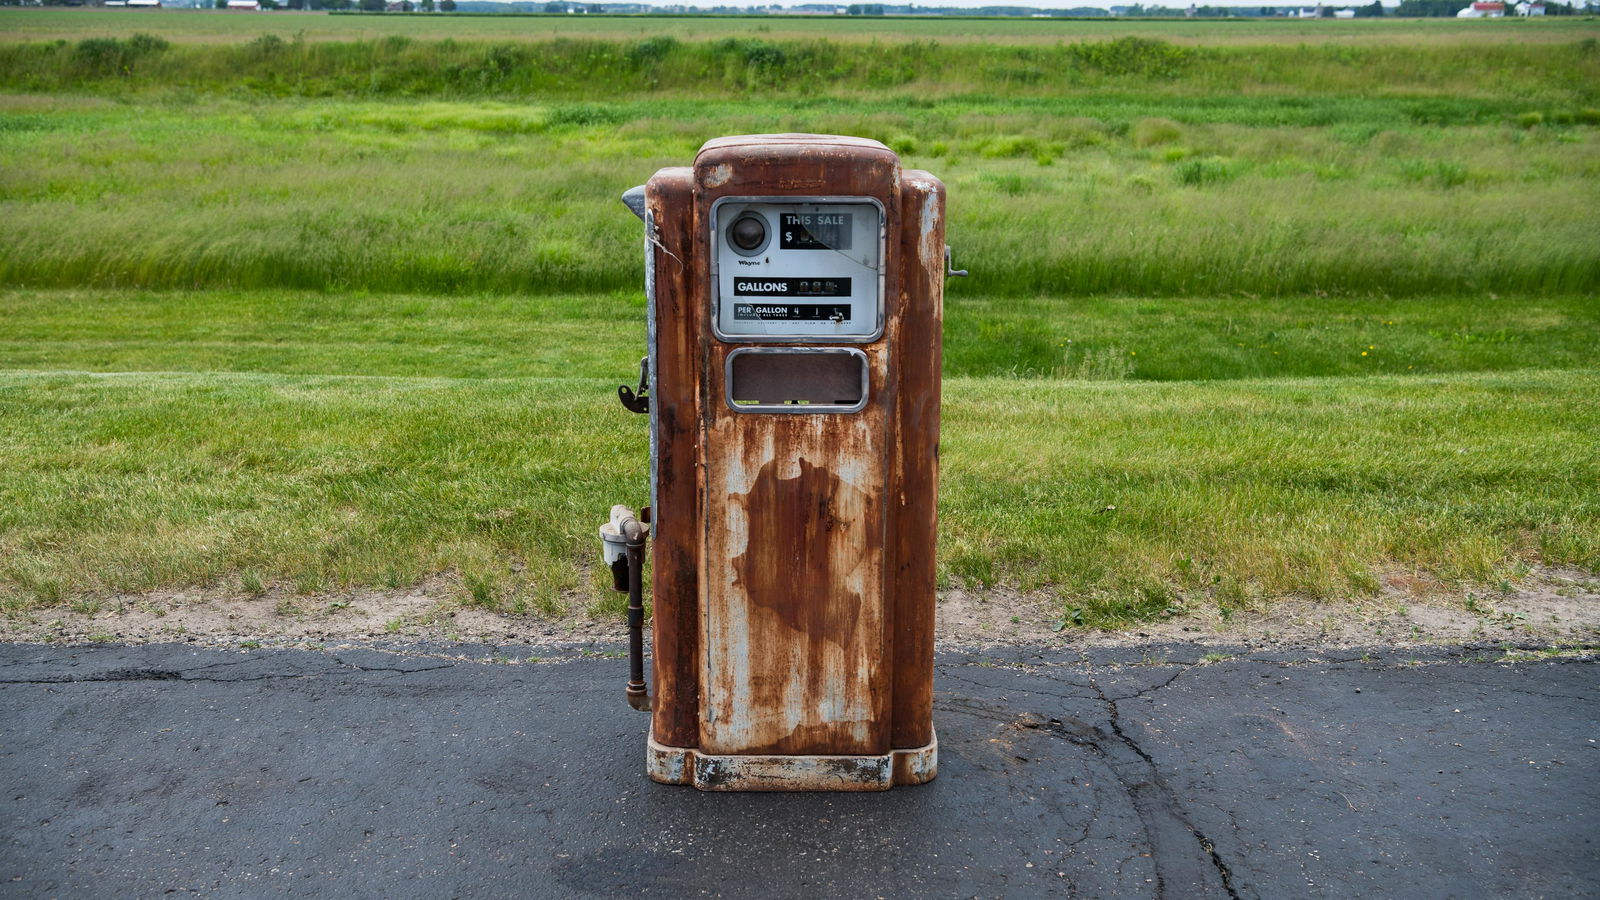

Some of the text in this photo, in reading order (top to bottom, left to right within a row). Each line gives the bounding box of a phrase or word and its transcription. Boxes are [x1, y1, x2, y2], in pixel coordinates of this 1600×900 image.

[786, 216, 844, 225] THIS SALE
[785, 231, 793, 243] $
[738, 282, 788, 292] GALLONS
